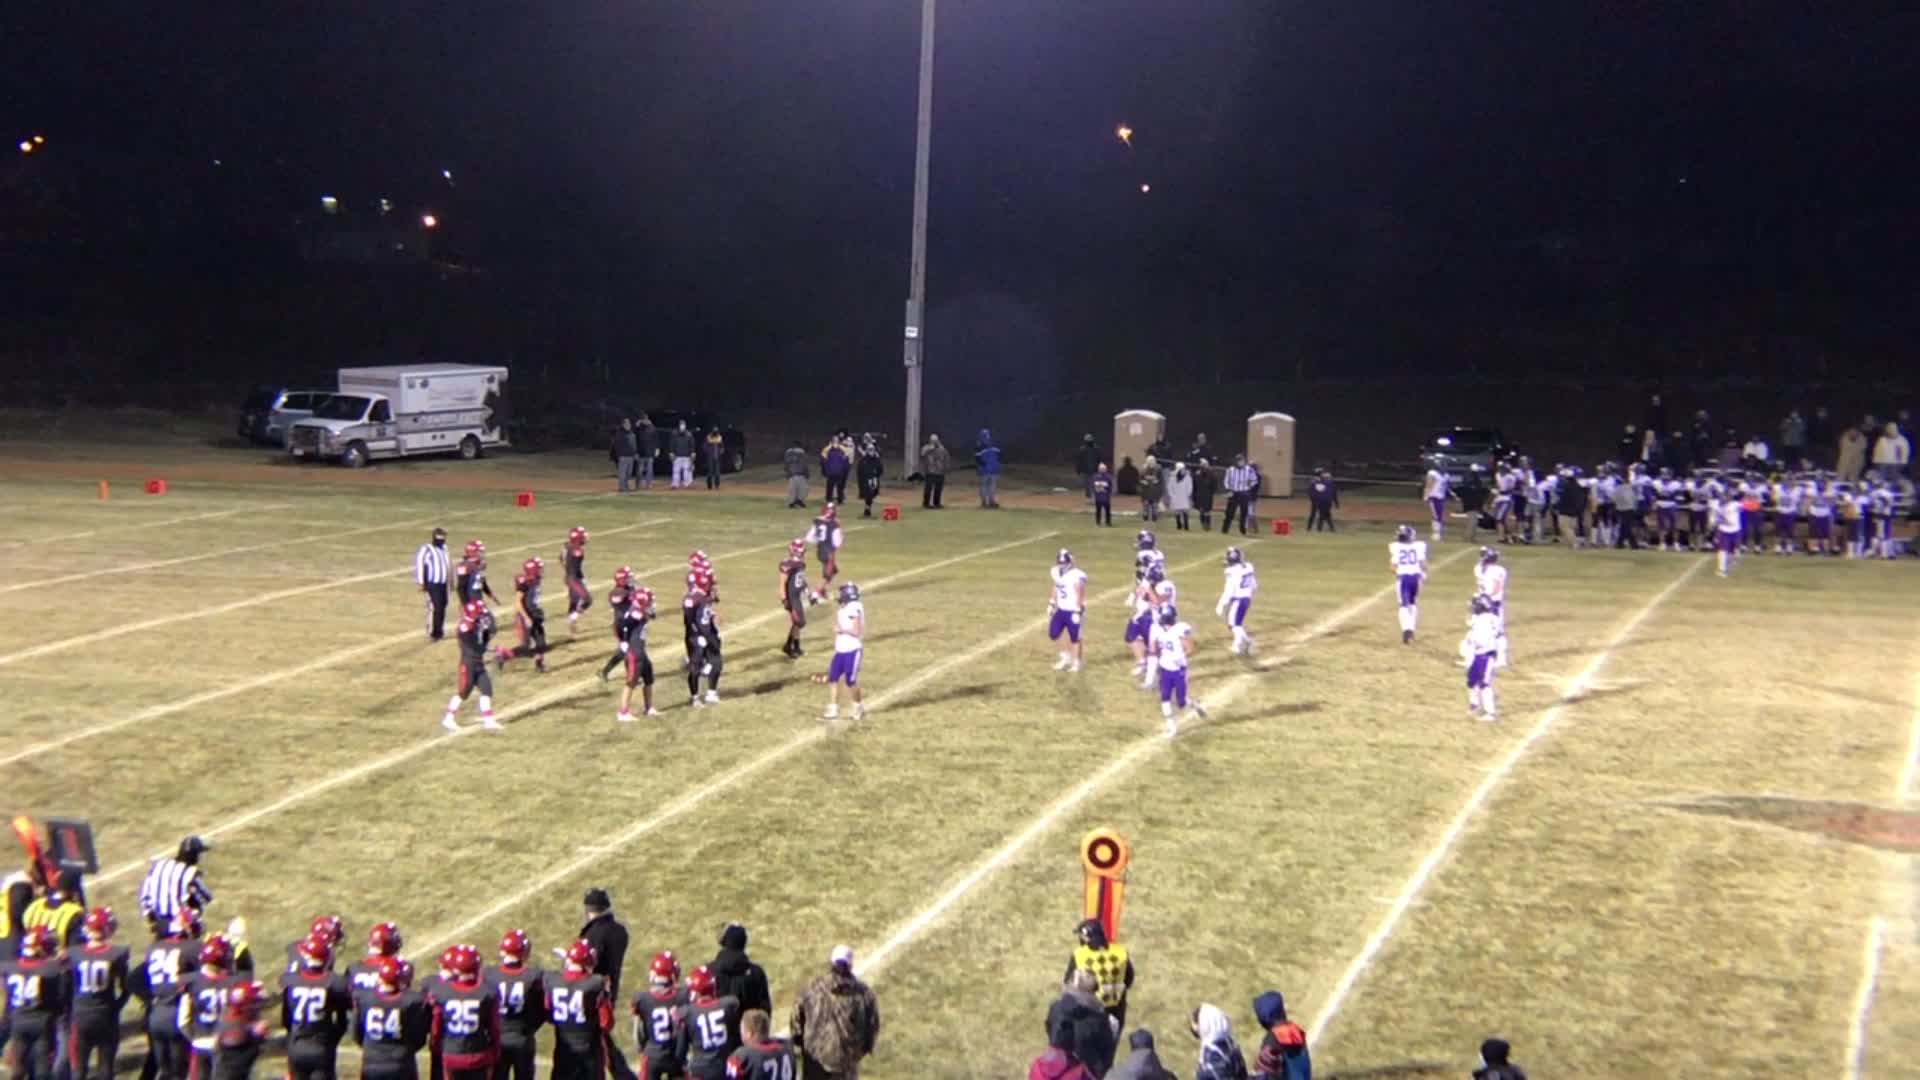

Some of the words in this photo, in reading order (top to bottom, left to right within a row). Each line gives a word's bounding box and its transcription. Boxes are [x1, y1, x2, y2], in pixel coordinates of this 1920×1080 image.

[883, 507, 899, 521] 20
[1399, 549, 1416, 565] 20
[77, 960, 109, 993] 10
[147, 948, 180, 985] 24
[7, 973, 41, 1008] 34
[292, 985, 326, 1022] 72
[498, 980, 525, 1014] 14
[552, 986, 586, 1023] 54
[366, 1007, 402, 1040] 64
[444, 999, 481, 1034] 35
[697, 1009, 728, 1050] 15
